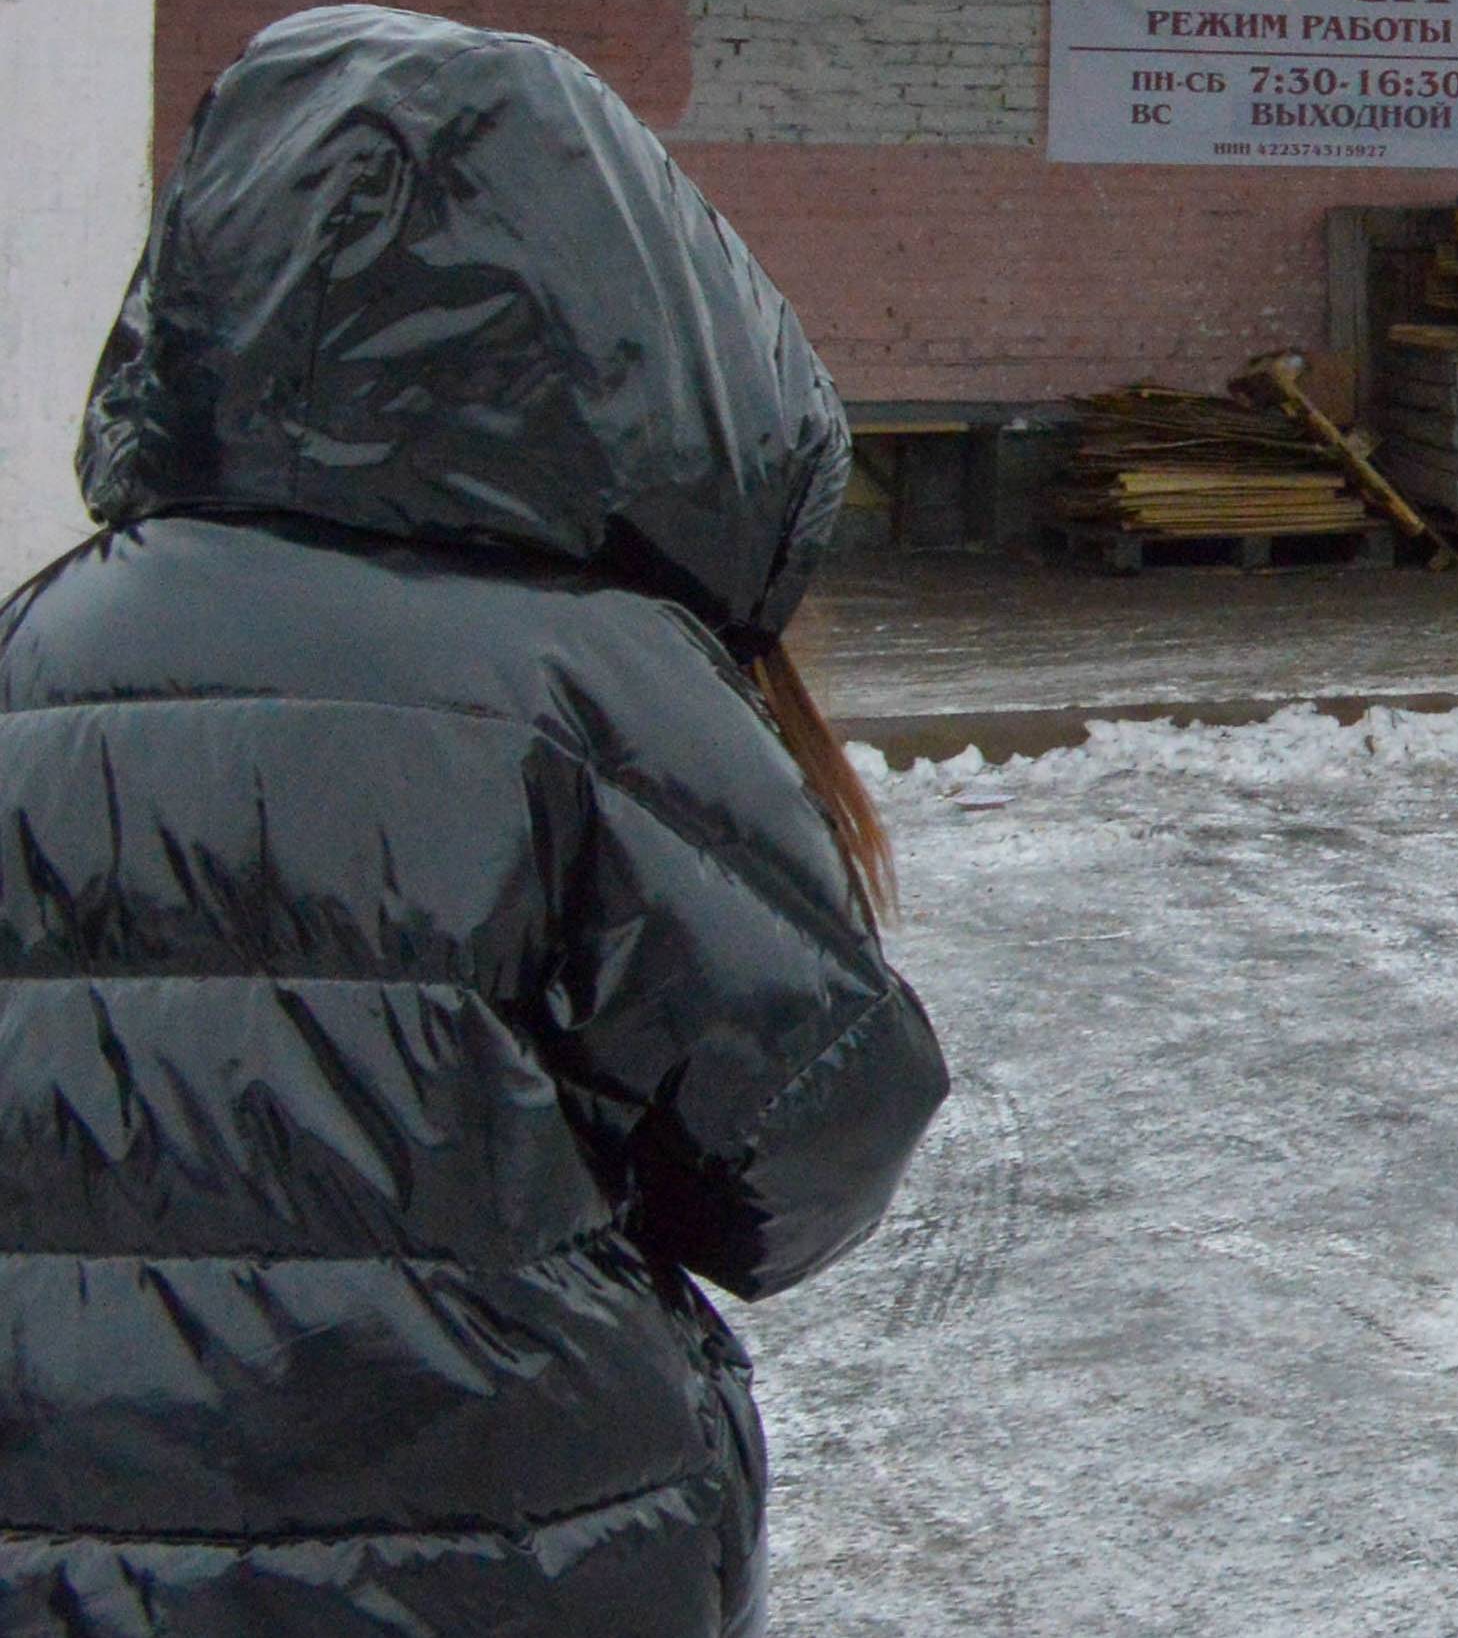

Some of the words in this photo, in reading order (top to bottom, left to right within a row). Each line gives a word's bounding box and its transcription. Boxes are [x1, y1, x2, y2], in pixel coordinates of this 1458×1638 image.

[1147, 11, 1287, 39] РЕЖИМ
[1302, 16, 1452, 44] РАБОТЫ
[1132, 71, 1226, 93] ПН-СБ
[1131, 103, 1172, 125] ВС
[1250, 101, 1452, 132] ВЫХОДНОЙ
